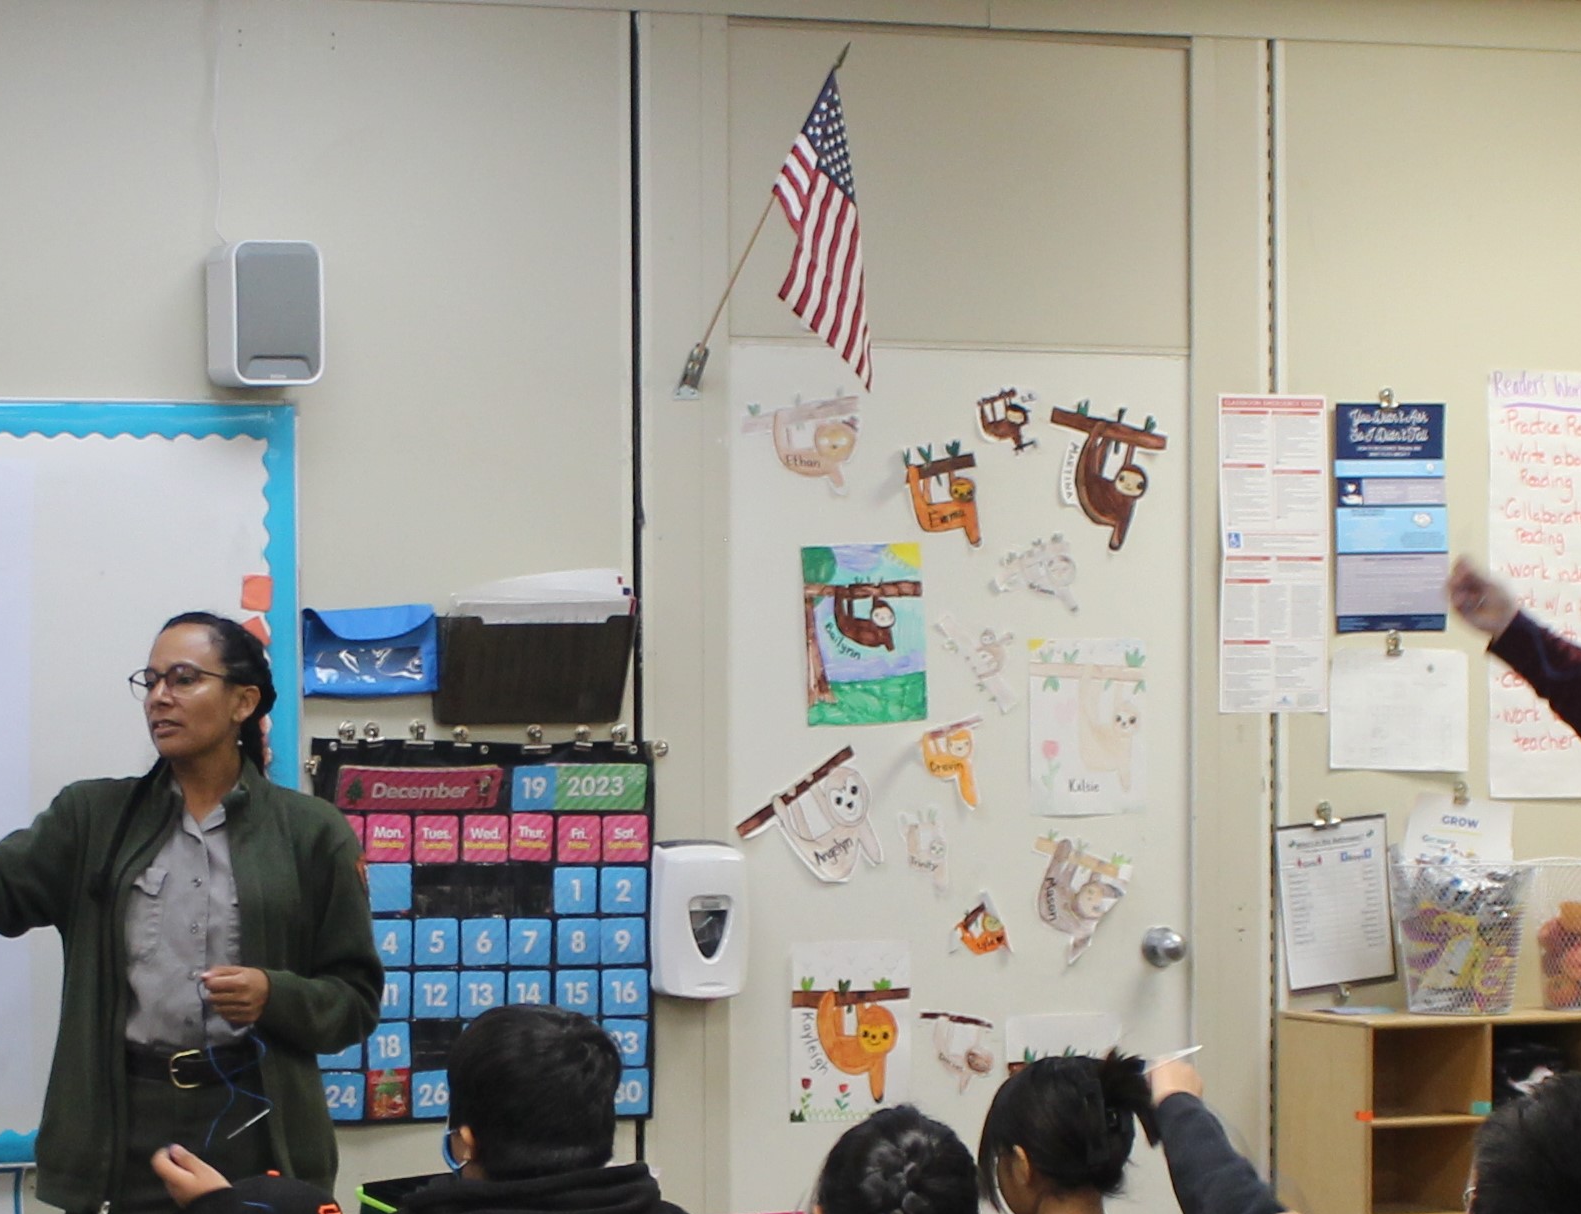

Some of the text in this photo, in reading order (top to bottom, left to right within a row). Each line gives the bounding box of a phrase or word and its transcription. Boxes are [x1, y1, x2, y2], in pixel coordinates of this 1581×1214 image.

[370, 775, 627, 801] December 19 2023
[373, 826, 405, 840] Mon.
[422, 827, 452, 840] Tues.
[469, 827, 501, 840] Wed.
[519, 826, 547, 839] Thur.
[1441, 814, 1480, 829] GROW
[571, 879, 632, 903] 1 2
[381, 930, 632, 955] 4 5 6 7 8 9
[423, 981, 638, 1007] 12 13 14 15 16
[377, 1035, 401, 1058] 18
[325, 1083, 450, 1109] 24 26
